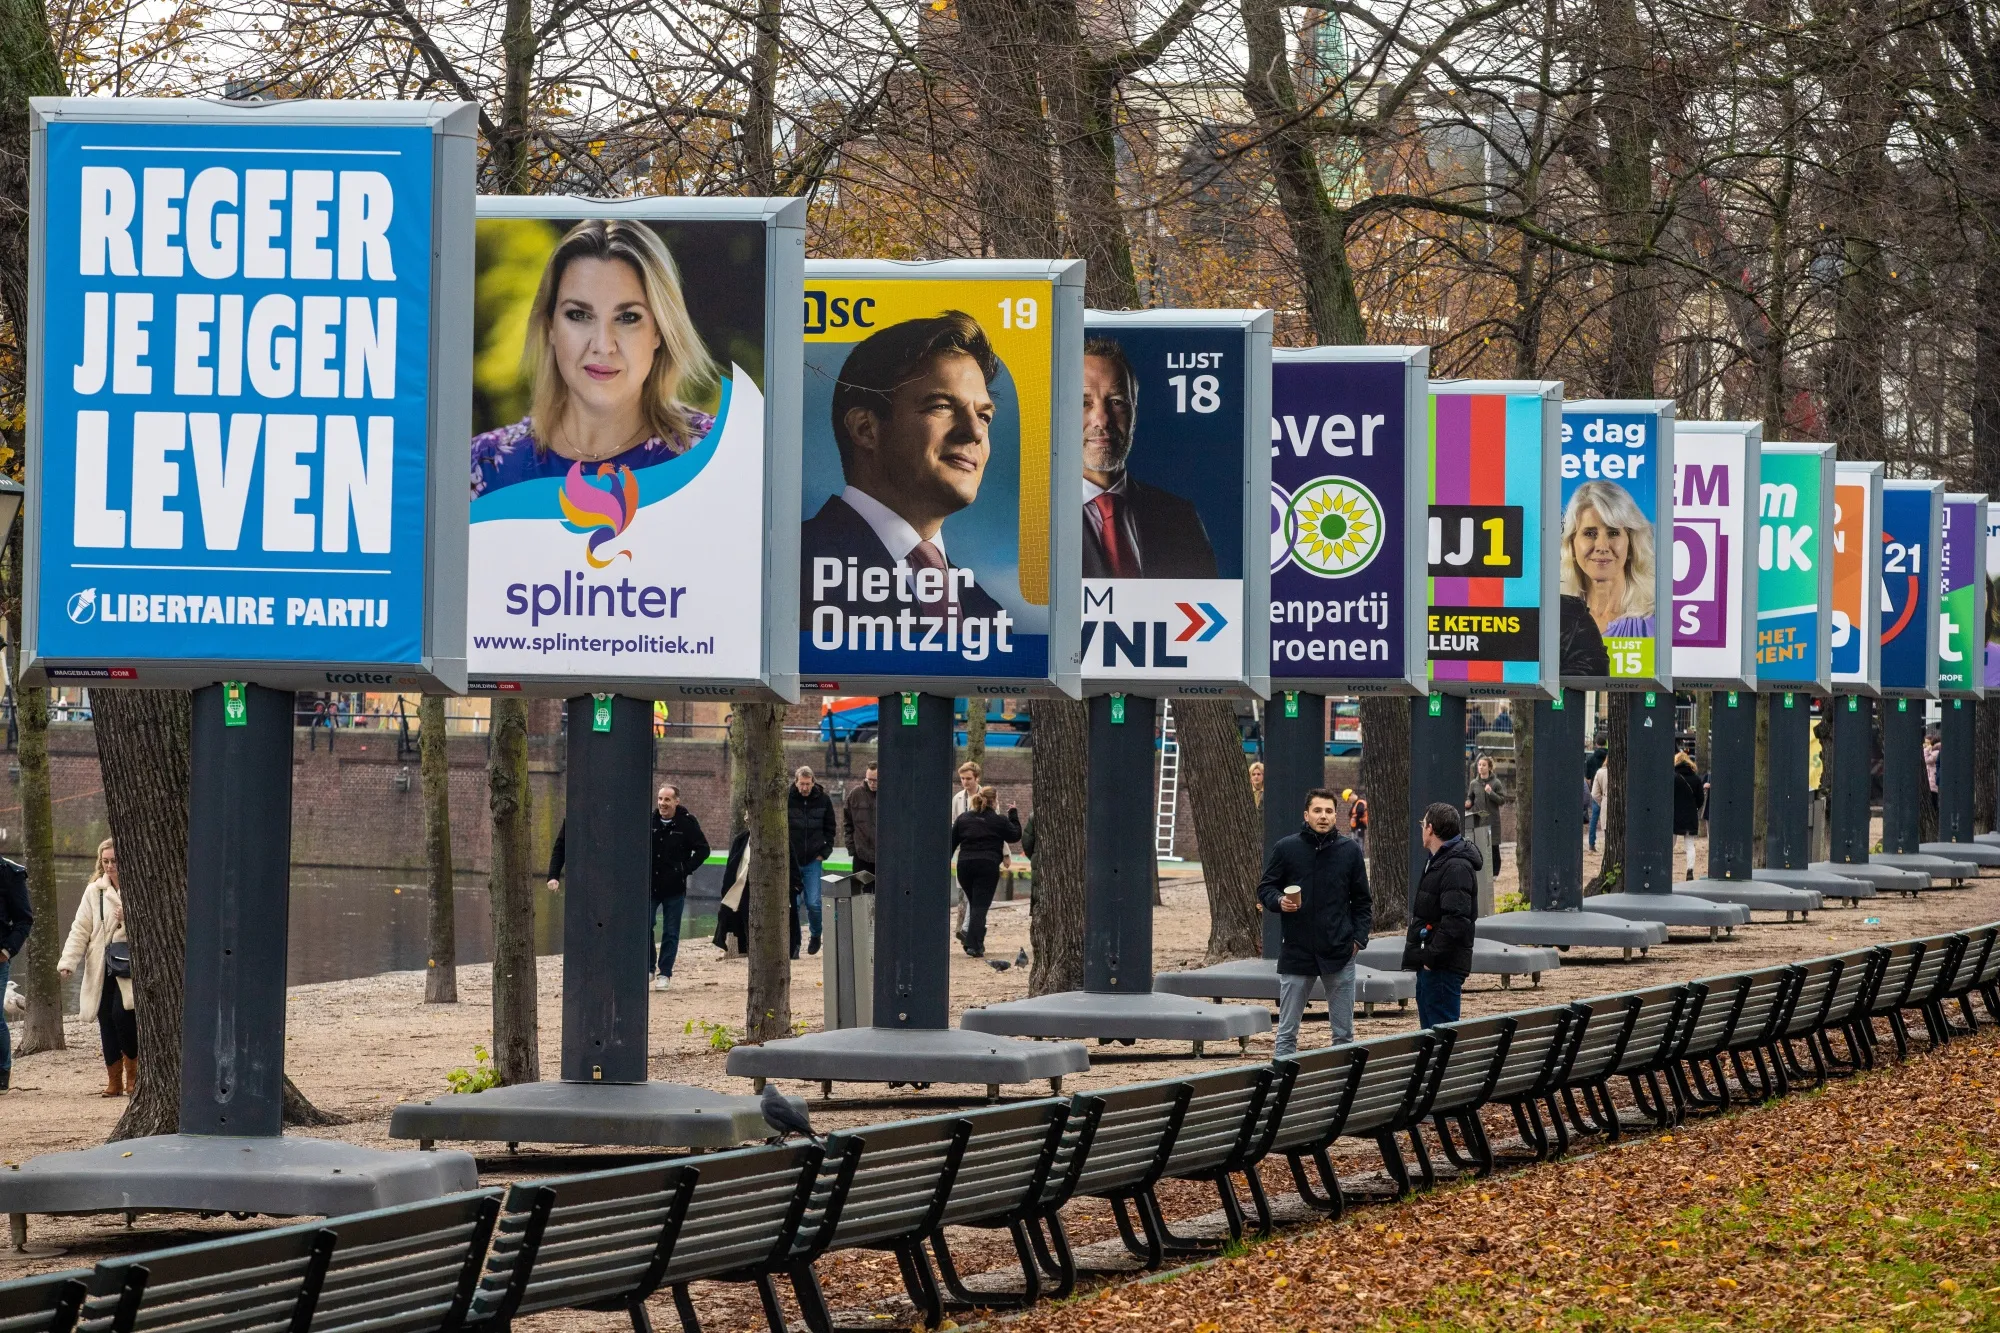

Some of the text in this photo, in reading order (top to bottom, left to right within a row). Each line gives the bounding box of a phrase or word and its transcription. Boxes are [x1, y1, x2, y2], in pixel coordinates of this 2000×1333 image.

[79, 166, 397, 282] REGEER
[997, 297, 1038, 329] 19
[73, 291, 398, 399] JE EIGEN
[1166, 352, 1224, 369] LIJST
[1168, 374, 1221, 414] 18
[1583, 418, 1645, 448] dag
[73, 410, 395, 554] LEVEN
[1884, 542, 1921, 573] 21
[813, 556, 975, 603] Pieter
[101, 593, 388, 628] LIBERTAIRE PARTIJ
[506, 570, 687, 627] splinter
[1084, 586, 1113, 614] M
[811, 605, 1014, 662] Omtzigt
[1444, 615, 1521, 633] KETENS
[1758, 627, 1797, 646] HET
[473, 633, 714, 656] www.splinterpolitiek.nl
[1272, 639, 1389, 661] roenen
[1428, 635, 1480, 651] LEUR
[1611, 641, 1642, 650] LIJST
[1612, 652, 1642, 674] 15
